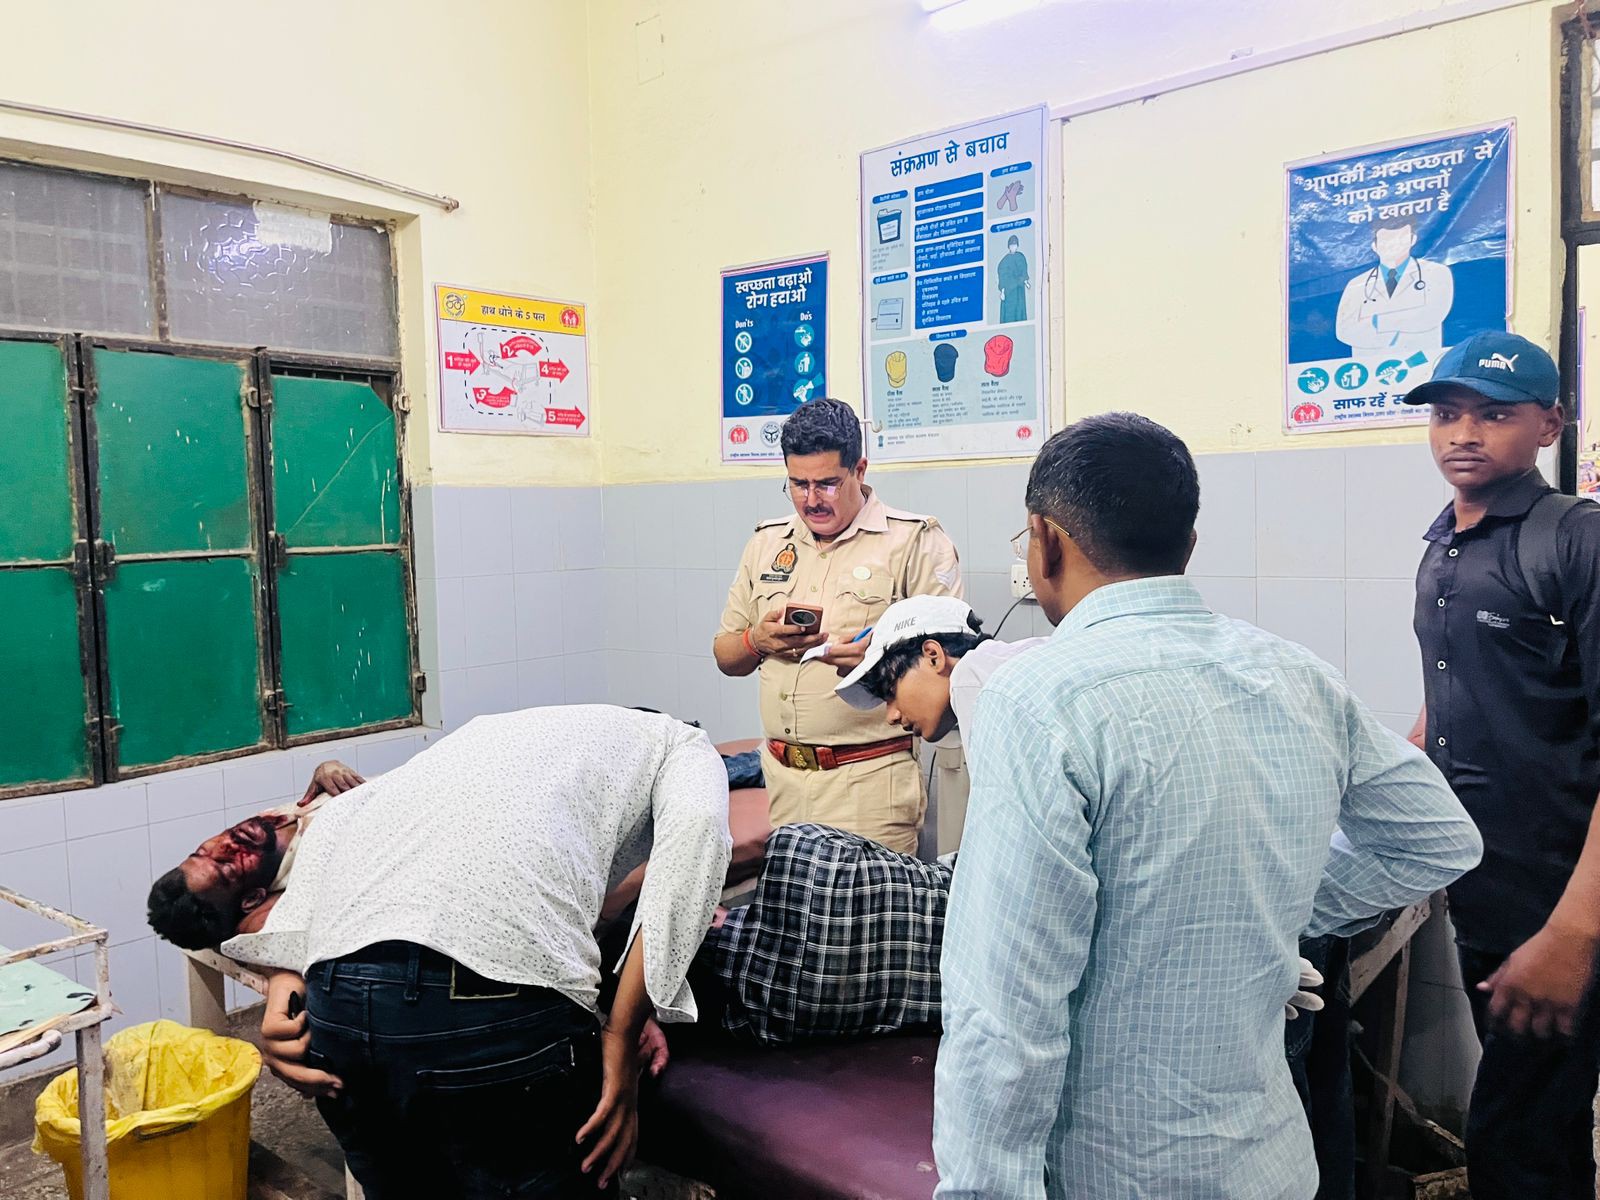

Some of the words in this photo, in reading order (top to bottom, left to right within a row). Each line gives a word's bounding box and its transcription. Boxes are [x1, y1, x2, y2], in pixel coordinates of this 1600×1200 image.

[890, 151, 940, 177] संक्रमण
[945, 140, 960, 164] से
[965, 132, 1010, 157] बचाव
[1303, 163, 1365, 191] आपकी
[1369, 148, 1465, 179] अस्वच्छता
[1474, 139, 1496, 161] से
[1331, 180, 1389, 207] आपके
[1394, 167, 1454, 195] अपनों
[1347, 204, 1373, 224] को
[1378, 198, 1432, 220] खतरा
[1437, 188, 1452, 212] है
[735, 276, 776, 294] स्वच्छता
[777, 267, 813, 290] बढ़ाओ
[745, 291, 769, 310] रोग
[770, 284, 808, 308] हटाओ
[533, 313, 546, 322] पल
[447, 356, 454, 367] 1
[1479, 359, 1506, 369] PUMA
[541, 366, 549, 375] 4
[476, 390, 486, 400] 3
[1333, 398, 1366, 410] साफ
[1368, 392, 1387, 407] रहें
[547, 411, 556, 422] 5
[893, 616, 917, 632] NIKE
